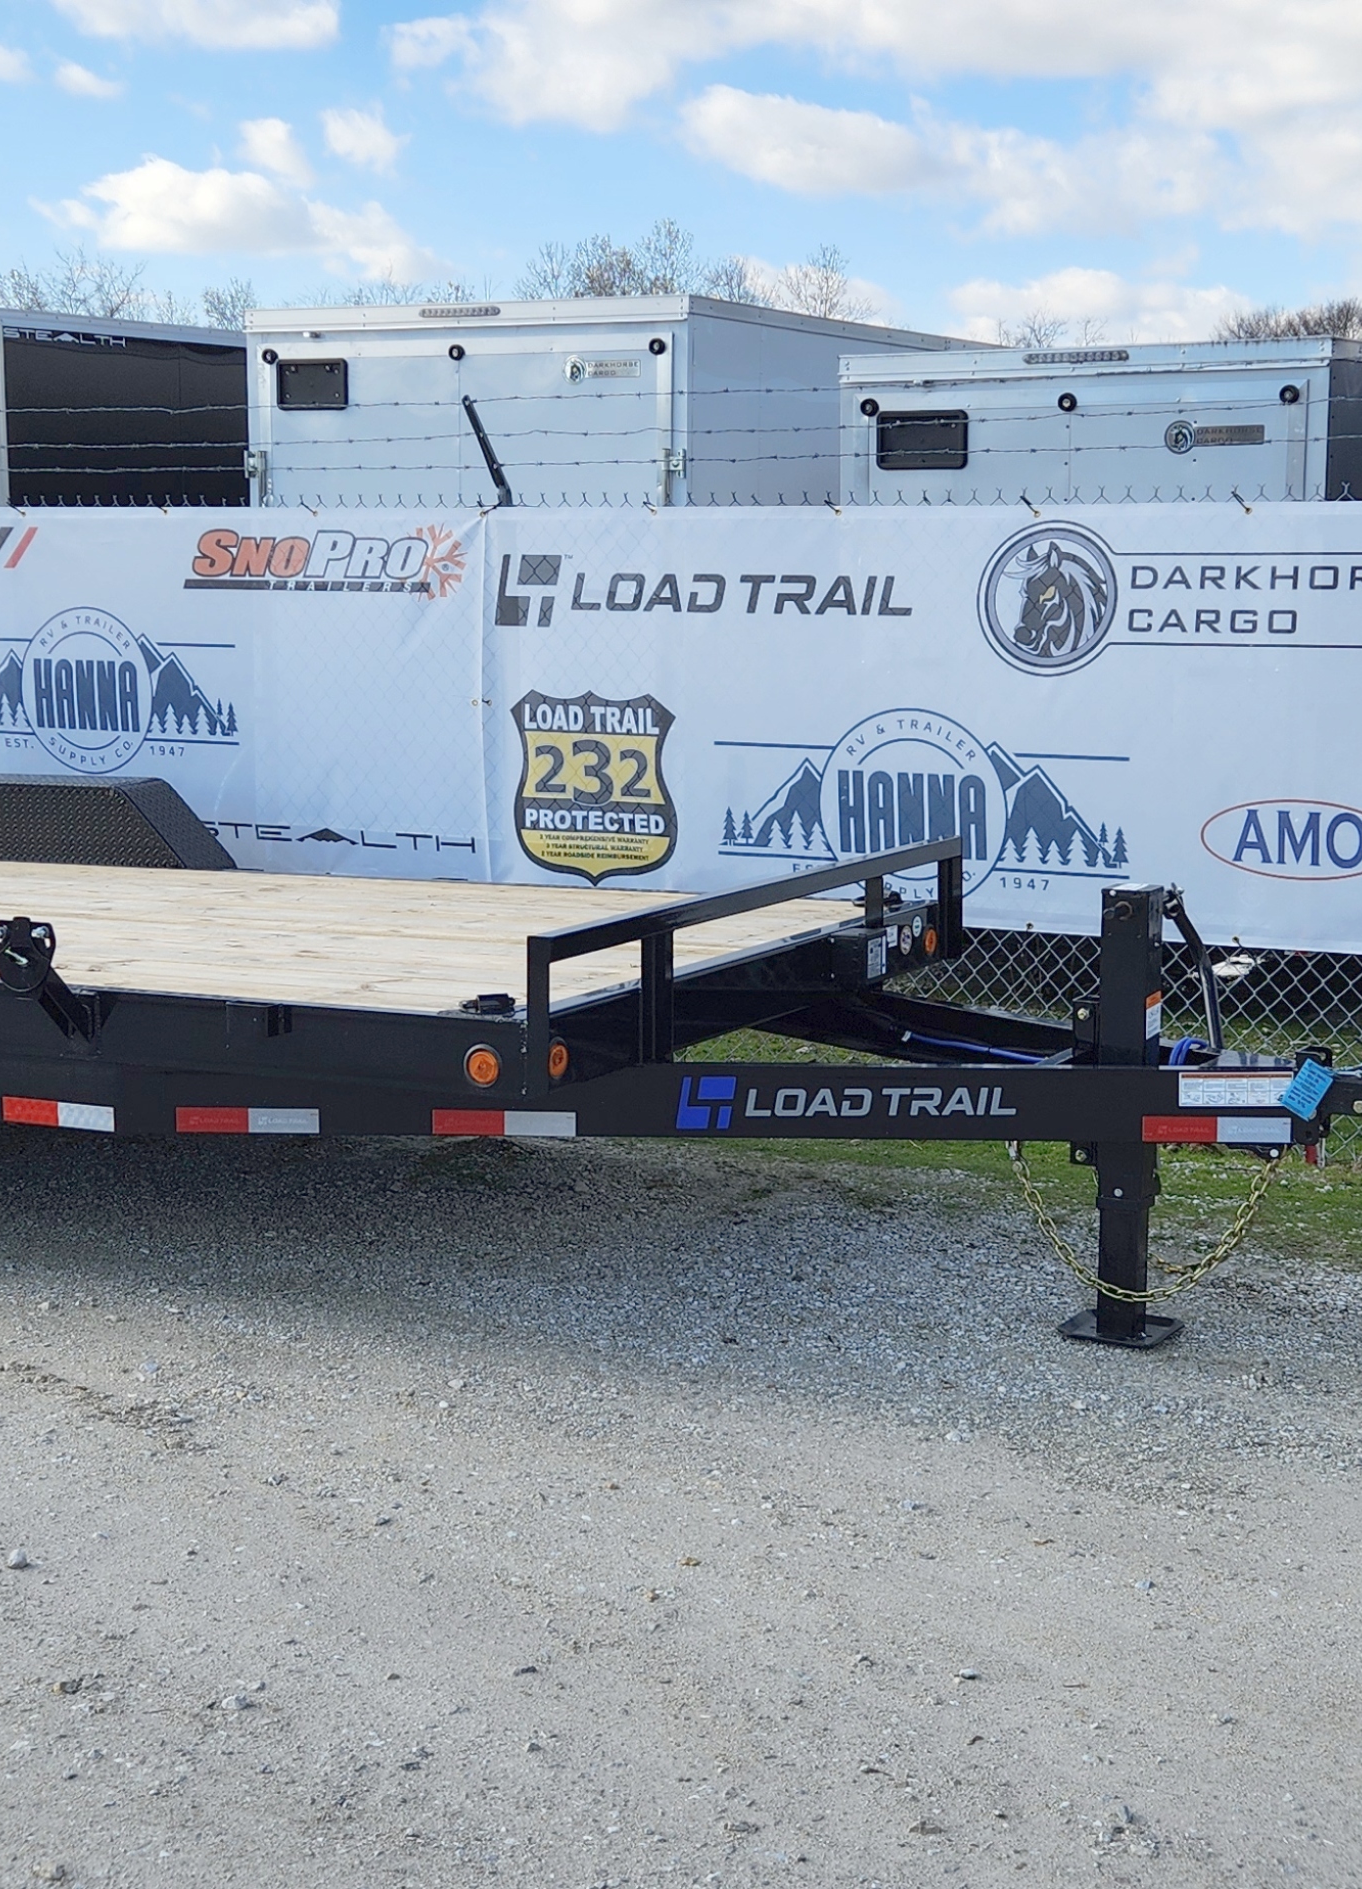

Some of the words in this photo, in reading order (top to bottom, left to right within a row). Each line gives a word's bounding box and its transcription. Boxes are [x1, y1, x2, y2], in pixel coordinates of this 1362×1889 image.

[269, 580, 412, 592] TRAILERS
[571, 572, 726, 613] LOAD
[740, 575, 913, 616] TRAIL
[39, 629, 54, 648] RV
[75, 615, 131, 649] TRAILER
[1128, 608, 1298, 634] CARGO
[33, 658, 140, 733] HANNA
[524, 703, 584, 731] LOAD
[590, 705, 660, 735] TRAIL
[5, 737, 34, 749] EST.
[48, 736, 106, 766] SUPPLY
[149, 745, 185, 757] 1947
[846, 734, 865, 756] RV
[876, 724, 886, 735] &
[897, 719, 976, 761] TRAILER
[534, 739, 652, 806] 232
[525, 808, 665, 835] PROTECTED
[838, 769, 987, 861] HANNA
[999, 876, 1051, 891] 1947
[744, 1087, 873, 1118] LOAD
[881, 1086, 1017, 1116] TRAIL
